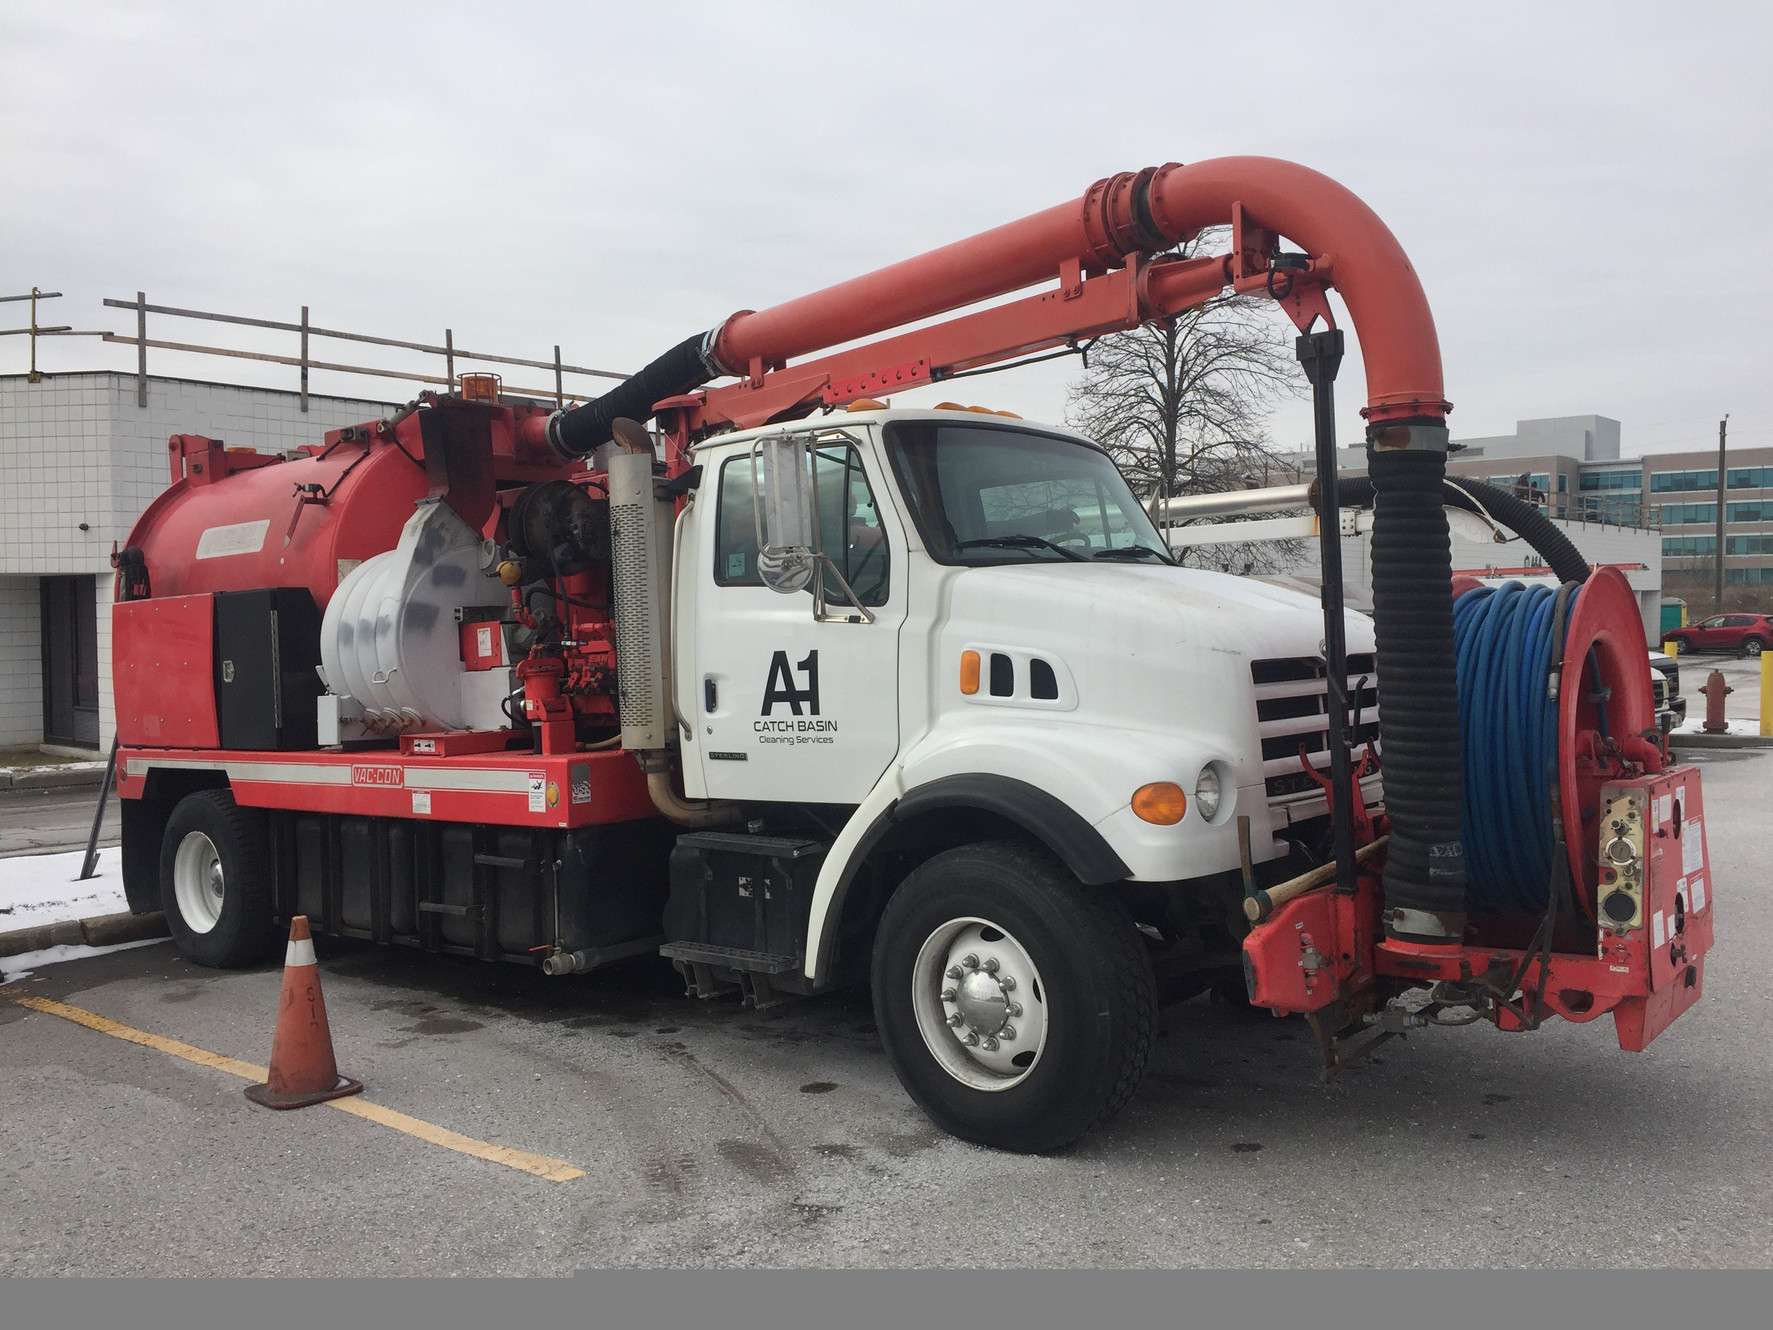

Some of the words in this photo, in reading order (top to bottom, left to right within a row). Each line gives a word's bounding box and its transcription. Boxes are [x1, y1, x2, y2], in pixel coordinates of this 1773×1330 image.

[753, 720, 794, 732] CATCH
[797, 720, 838, 732] BASIN
[759, 735, 795, 746] Cleaning
[796, 735, 834, 744] Services
[710, 752, 746, 761] STERLING
